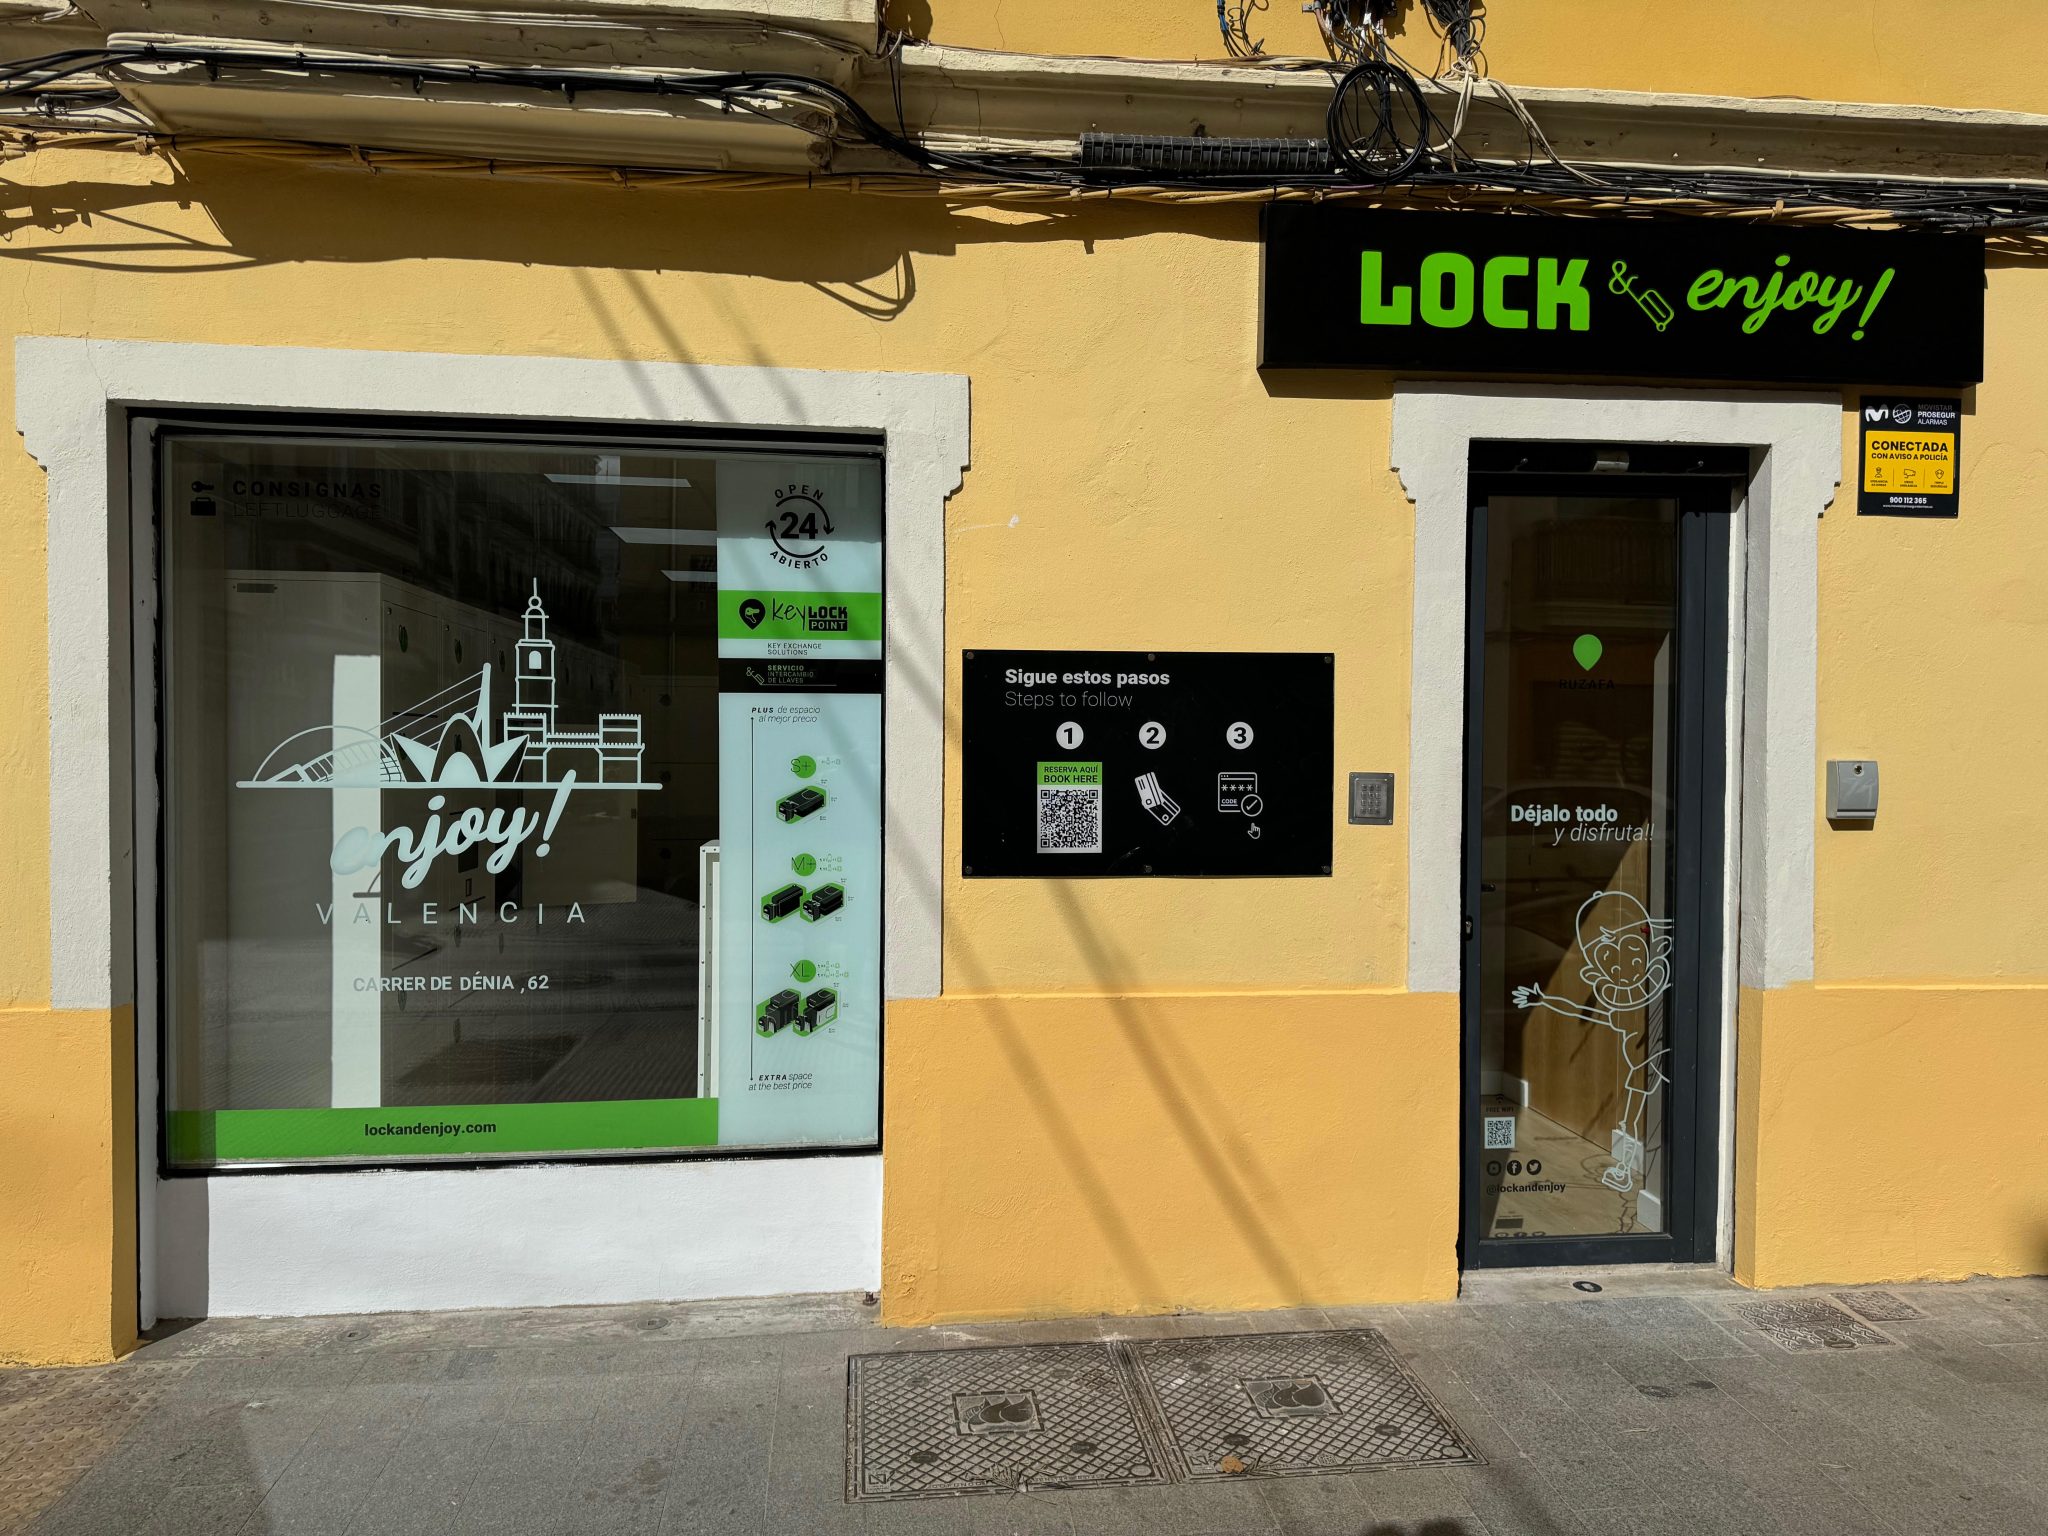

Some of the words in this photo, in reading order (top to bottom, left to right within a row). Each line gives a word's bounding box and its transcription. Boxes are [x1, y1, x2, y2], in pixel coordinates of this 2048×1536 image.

[1360, 250, 1591, 332] LOCK
[1686, 254, 1896, 341] enjoy!
[1917, 411, 1956, 419] PROSEGUR
[1917, 418, 1948, 426] ALARMAS
[1871, 440, 1948, 452] CONECTADA
[1871, 452, 1889, 460] CON
[1919, 453, 1948, 461] POLICÍA
[232, 479, 382, 499] CONSIGNAS
[774, 484, 824, 501] OPEN
[1889, 496, 1903, 504] 900
[1903, 496, 1914, 504] 112
[1914, 497, 1927, 505] 365
[780, 511, 818, 540] 24
[769, 550, 828, 570] ABIERTO
[811, 621, 846, 630] POINT
[767, 664, 805, 672] SERVICIO
[1005, 668, 1058, 688] Sigue
[1062, 670, 1112, 685] estos
[1116, 673, 1170, 689] pasos
[1559, 679, 1616, 690] RUZAFA
[1005, 690, 1055, 710] Steps
[1059, 692, 1077, 707] to
[1082, 690, 1133, 707] follow
[751, 706, 774, 714] PLUS
[777, 705, 788, 714] de
[789, 706, 821, 716] espacio
[758, 714, 767, 723] al
[767, 715, 791, 724] mejor
[792, 715, 818, 724] precio
[1064, 728, 1073, 744] 1
[1146, 727, 1160, 744] 2
[1233, 727, 1247, 744] 3
[1079, 765, 1098, 773] AQUÍ
[1043, 775, 1071, 783] BOOK
[1073, 775, 1098, 783] HERE
[1510, 804, 1571, 826] Déjalo
[1576, 804, 1618, 822] todo
[1552, 826, 1566, 846] y
[1569, 823, 1655, 842] disfruta!!
[315, 901, 586, 926] VALENCIA
[789, 962, 810, 978] XL
[353, 976, 426, 992] CARRER
[430, 976, 453, 991] DE
[460, 971, 515, 991] DÉNIA
[788, 1073, 813, 1082] space
[748, 1082, 757, 1091] at
[758, 1082, 771, 1091] the
[772, 1082, 791, 1090] best
[792, 1081, 813, 1091] price
[364, 1122, 497, 1137] lockandenjoy.com
[1486, 1182, 1566, 1196] @lockandenjoy
